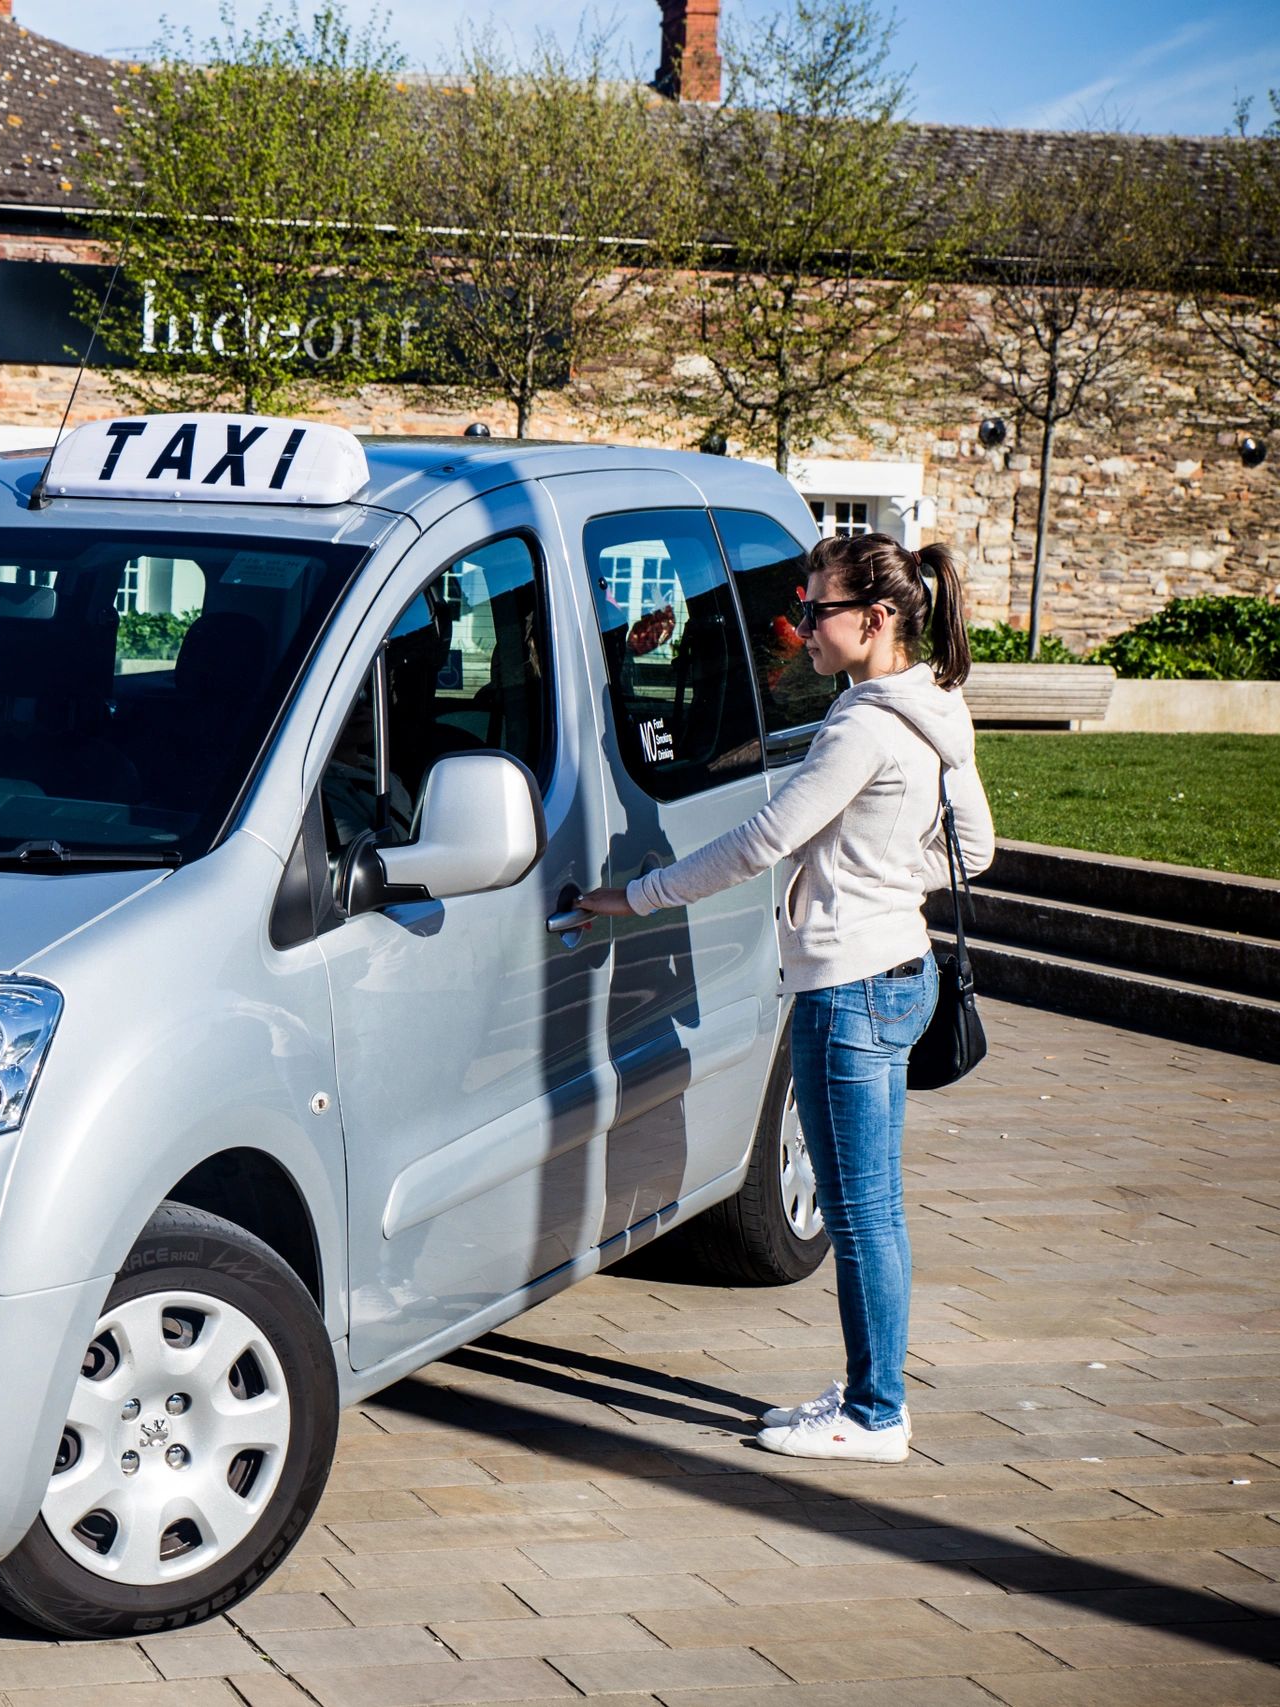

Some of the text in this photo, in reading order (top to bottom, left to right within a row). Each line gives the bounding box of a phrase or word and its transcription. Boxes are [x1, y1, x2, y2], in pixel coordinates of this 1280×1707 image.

[98, 422, 307, 490] TAXI
[639, 721, 657, 763] NO
[655, 732, 673, 745] Smoking
[657, 748, 674, 761] Drinking
